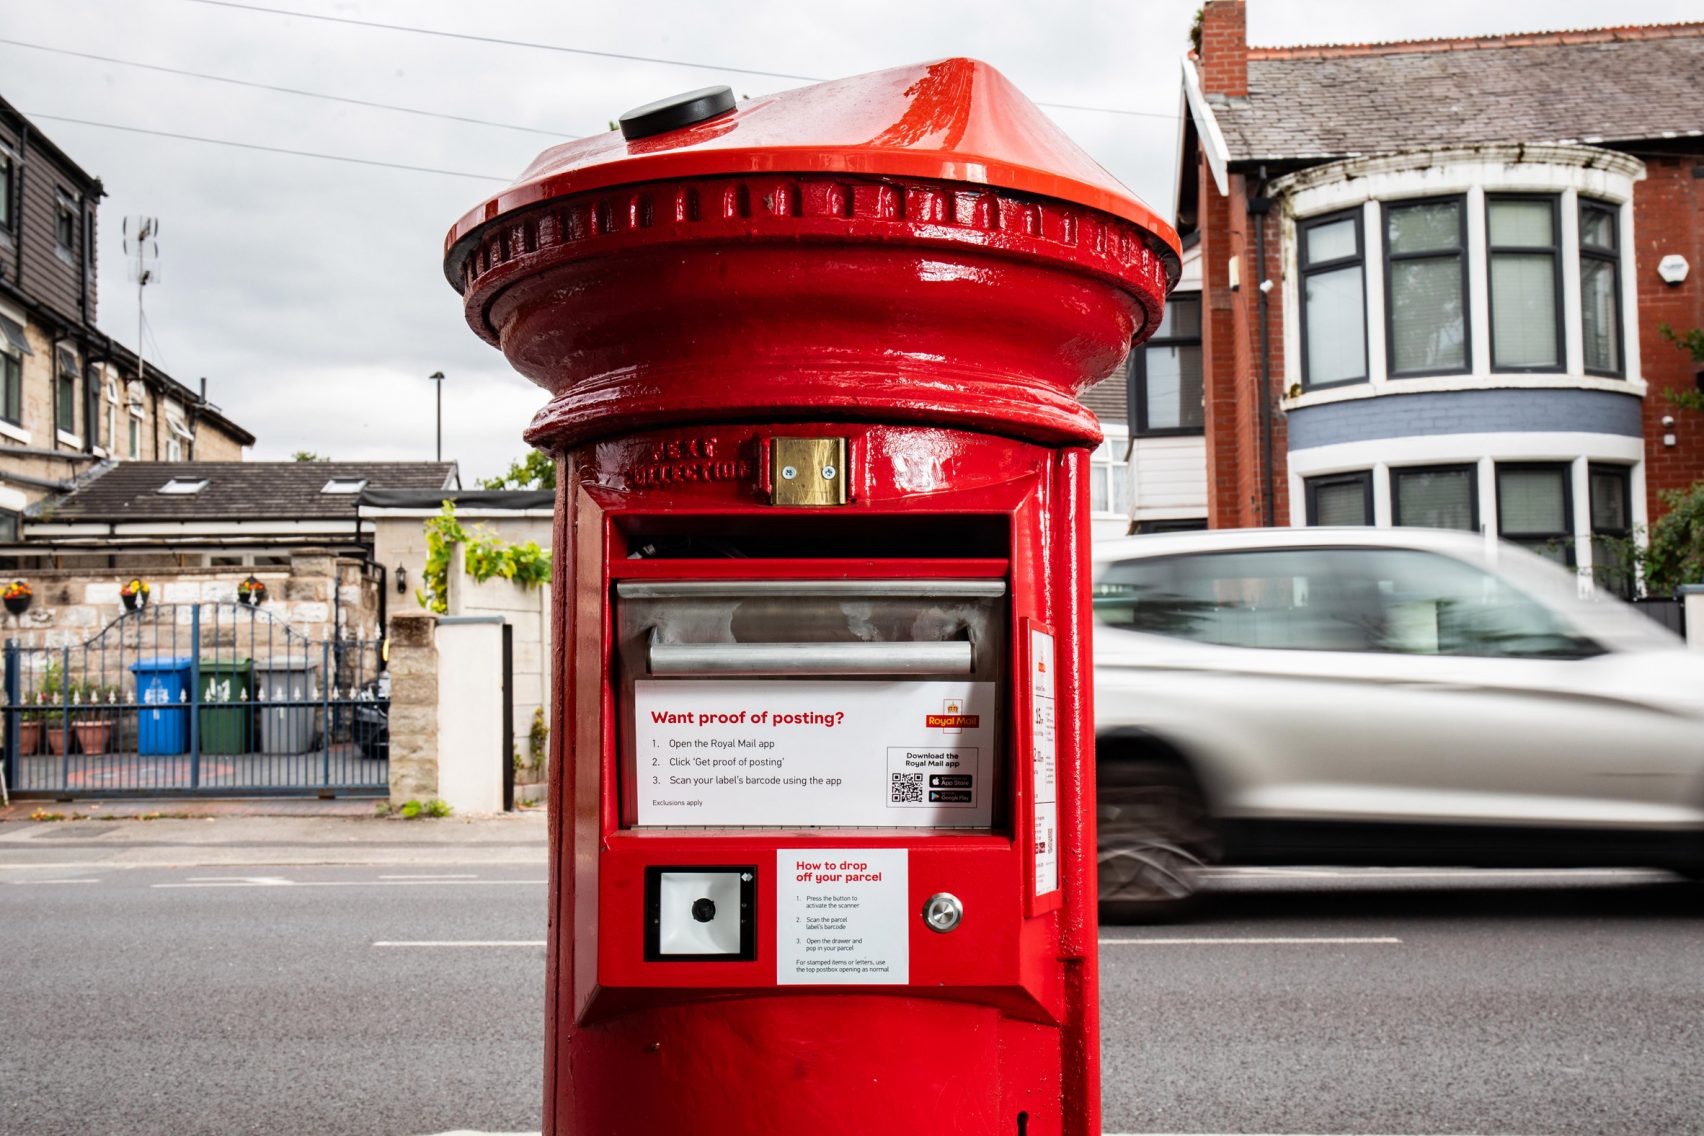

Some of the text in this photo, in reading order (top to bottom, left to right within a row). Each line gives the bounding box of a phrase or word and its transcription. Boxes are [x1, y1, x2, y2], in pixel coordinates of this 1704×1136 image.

[651, 711, 844, 727] Want proof of posting?
[929, 717, 976, 726] Royal Mail
[652, 739, 775, 750] 1. Open the Royal Mail app
[906, 752, 944, 760] Download
[652, 757, 660, 766] 2.
[669, 757, 691, 766] Click
[712, 757, 736, 768] proof
[738, 757, 747, 766] of
[905, 760, 926, 768] Royal
[652, 776, 660, 785] 3.
[669, 775, 692, 785] Scan
[693, 777, 714, 786] your
[745, 776, 781, 785] barcode
[783, 776, 807, 787] using
[809, 776, 824, 785] the
[825, 778, 842, 787] app
[686, 799, 703, 807] apply
[796, 861, 867, 872] How to drop
[796, 872, 882, 884] off your parcel
[806, 944, 817, 952] pop
[806, 959, 830, 967] stamped
